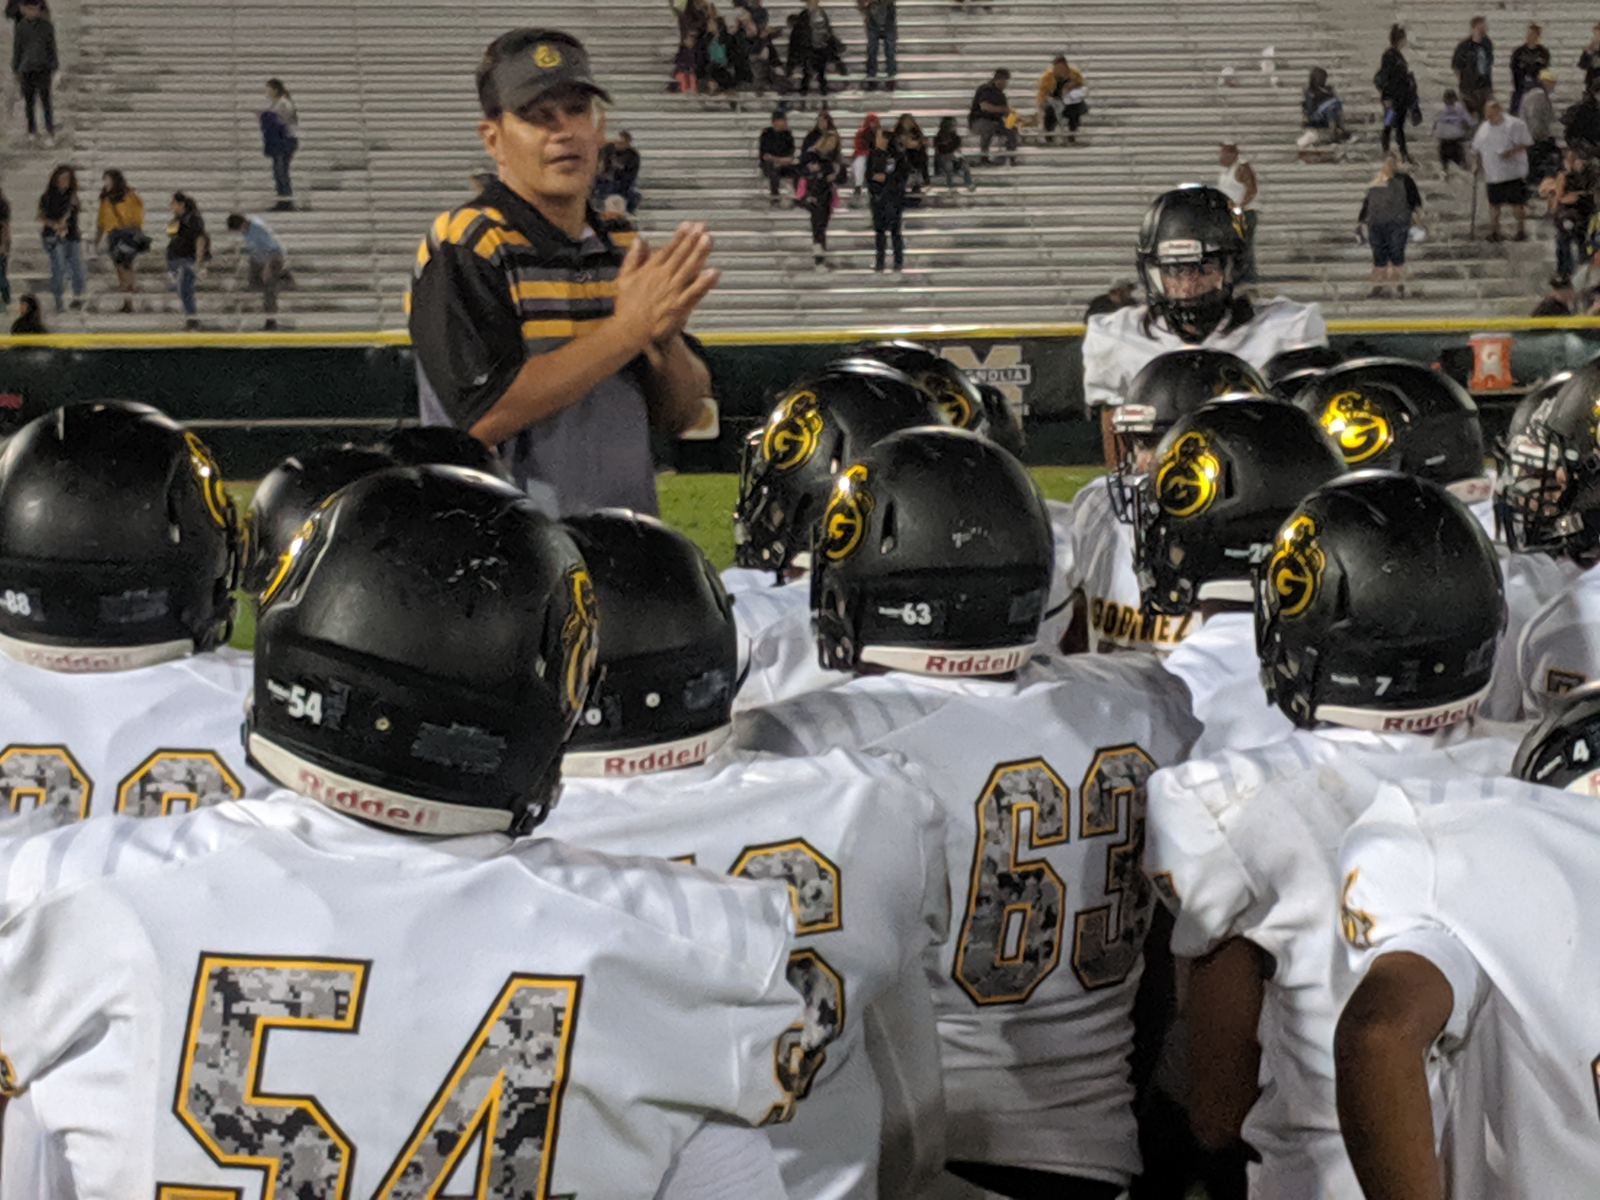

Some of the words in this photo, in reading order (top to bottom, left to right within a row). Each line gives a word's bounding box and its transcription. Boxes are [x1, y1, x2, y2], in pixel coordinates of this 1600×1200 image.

[902, 602, 932, 625] 63
[925, 652, 1020, 673] Riddell
[1374, 675, 1393, 697] 7
[288, 684, 323, 726] 54
[1382, 698, 1480, 731] Riddell
[604, 740, 707, 774] Riddell
[1572, 738, 1590, 763] 4
[951, 741, 1160, 1007] 63
[157, 950, 585, 1200] 54
